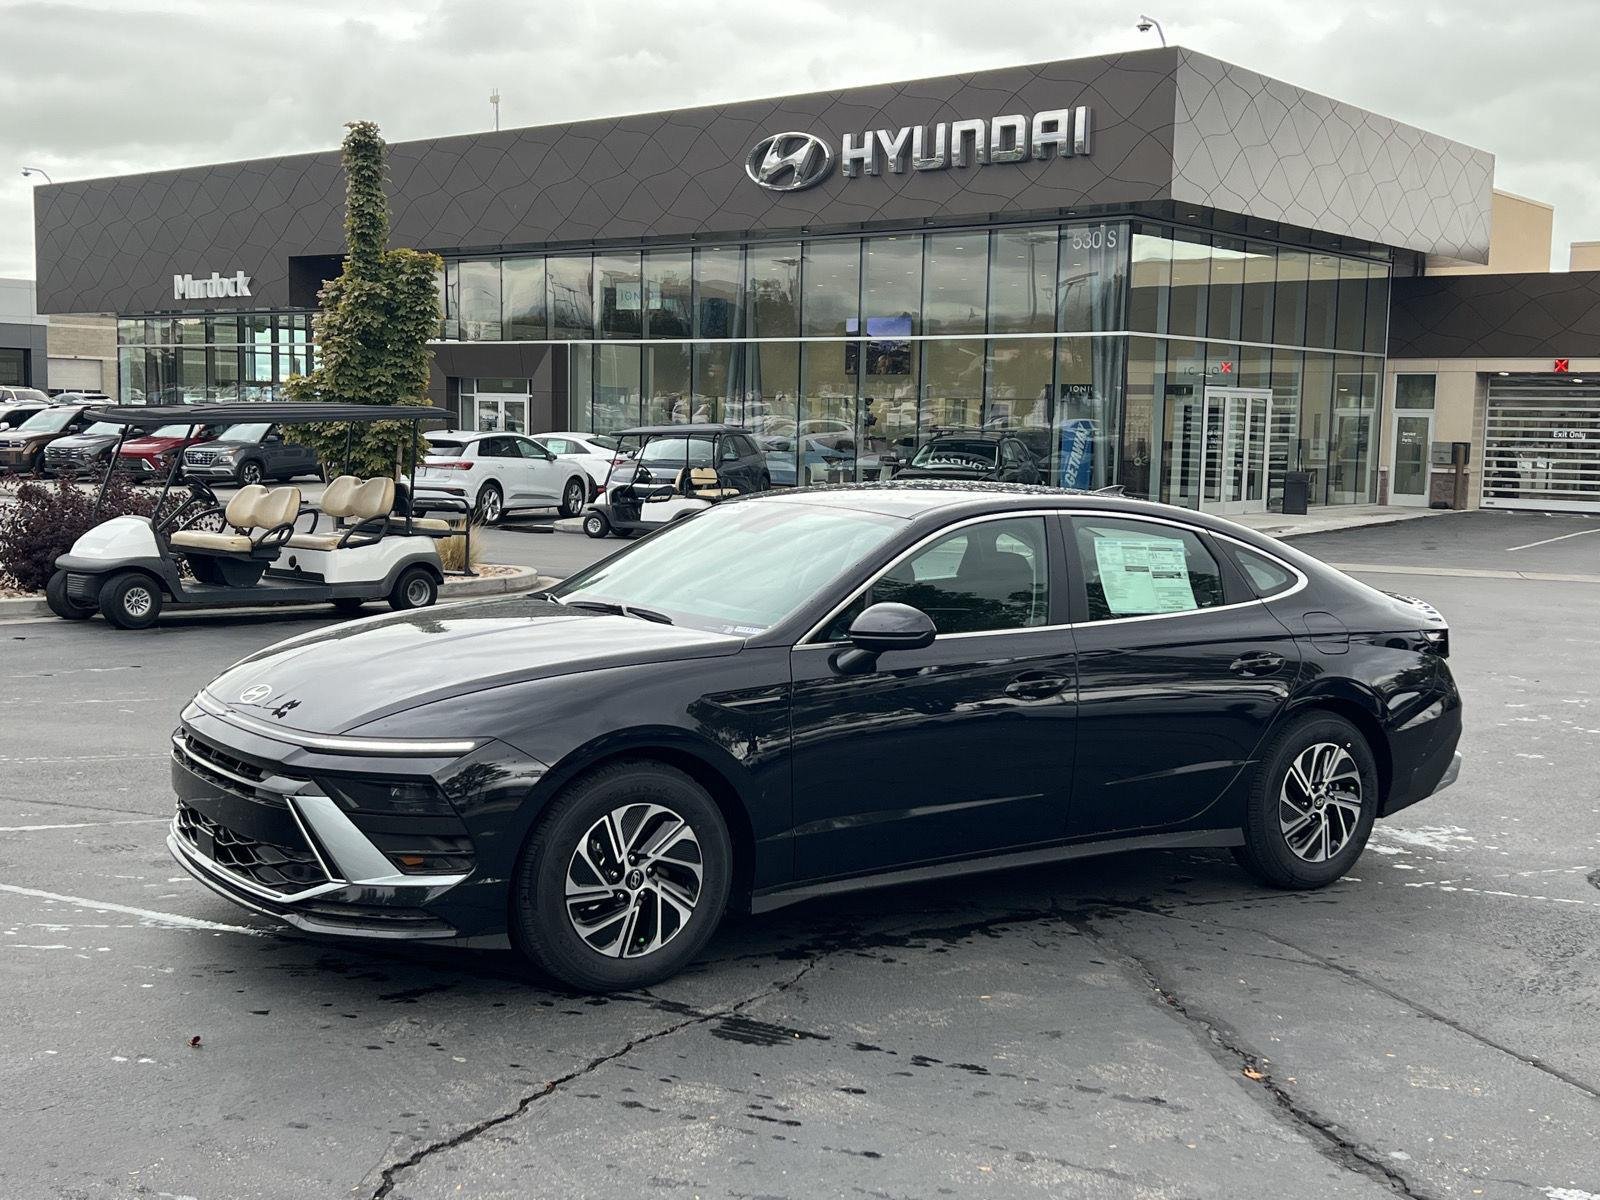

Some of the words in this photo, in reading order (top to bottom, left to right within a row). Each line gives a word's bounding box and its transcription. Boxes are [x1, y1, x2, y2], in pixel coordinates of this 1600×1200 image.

[842, 106, 1092, 178] HYUNDAI
[1073, 231, 1102, 250] 530
[1107, 230, 1117, 248] S
[173, 270, 252, 300] Murdock
[1553, 430, 1568, 438] Exit
[1569, 430, 1586, 440] Only
[1064, 421, 1090, 486] GETAWAY
